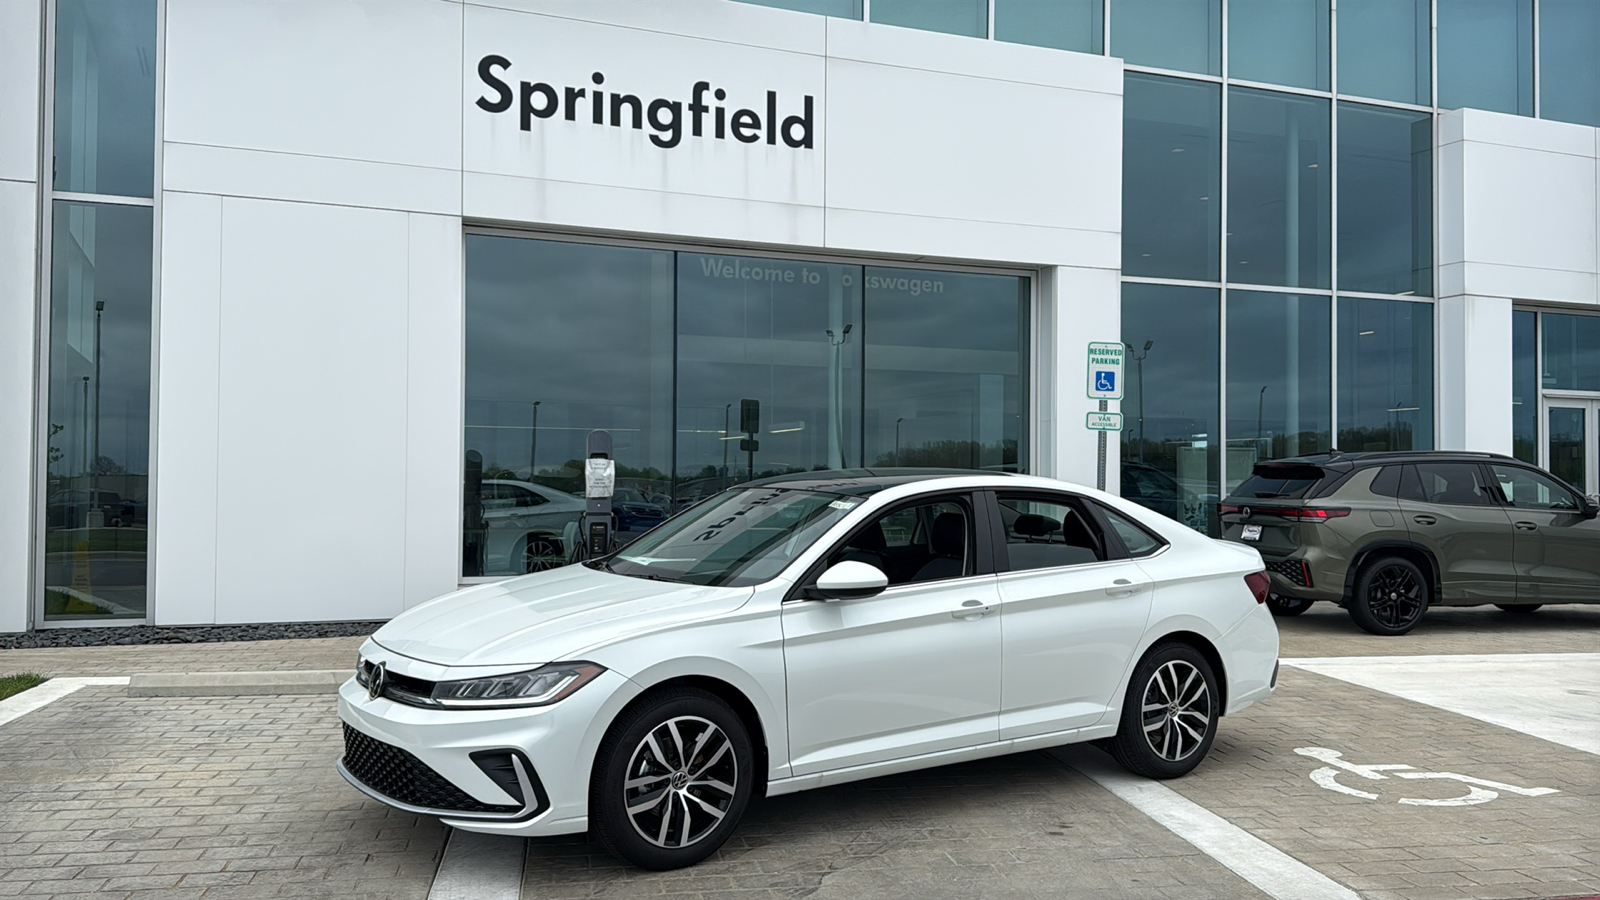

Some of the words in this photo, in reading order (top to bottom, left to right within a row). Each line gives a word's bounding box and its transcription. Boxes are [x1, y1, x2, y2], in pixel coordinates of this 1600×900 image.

[475, 54, 814, 149] Springfield
[701, 257, 795, 283] Welcome
[802, 267, 821, 284] to
[1089, 348, 1122, 356] RESERVED
[1091, 357, 1120, 365] PARKING
